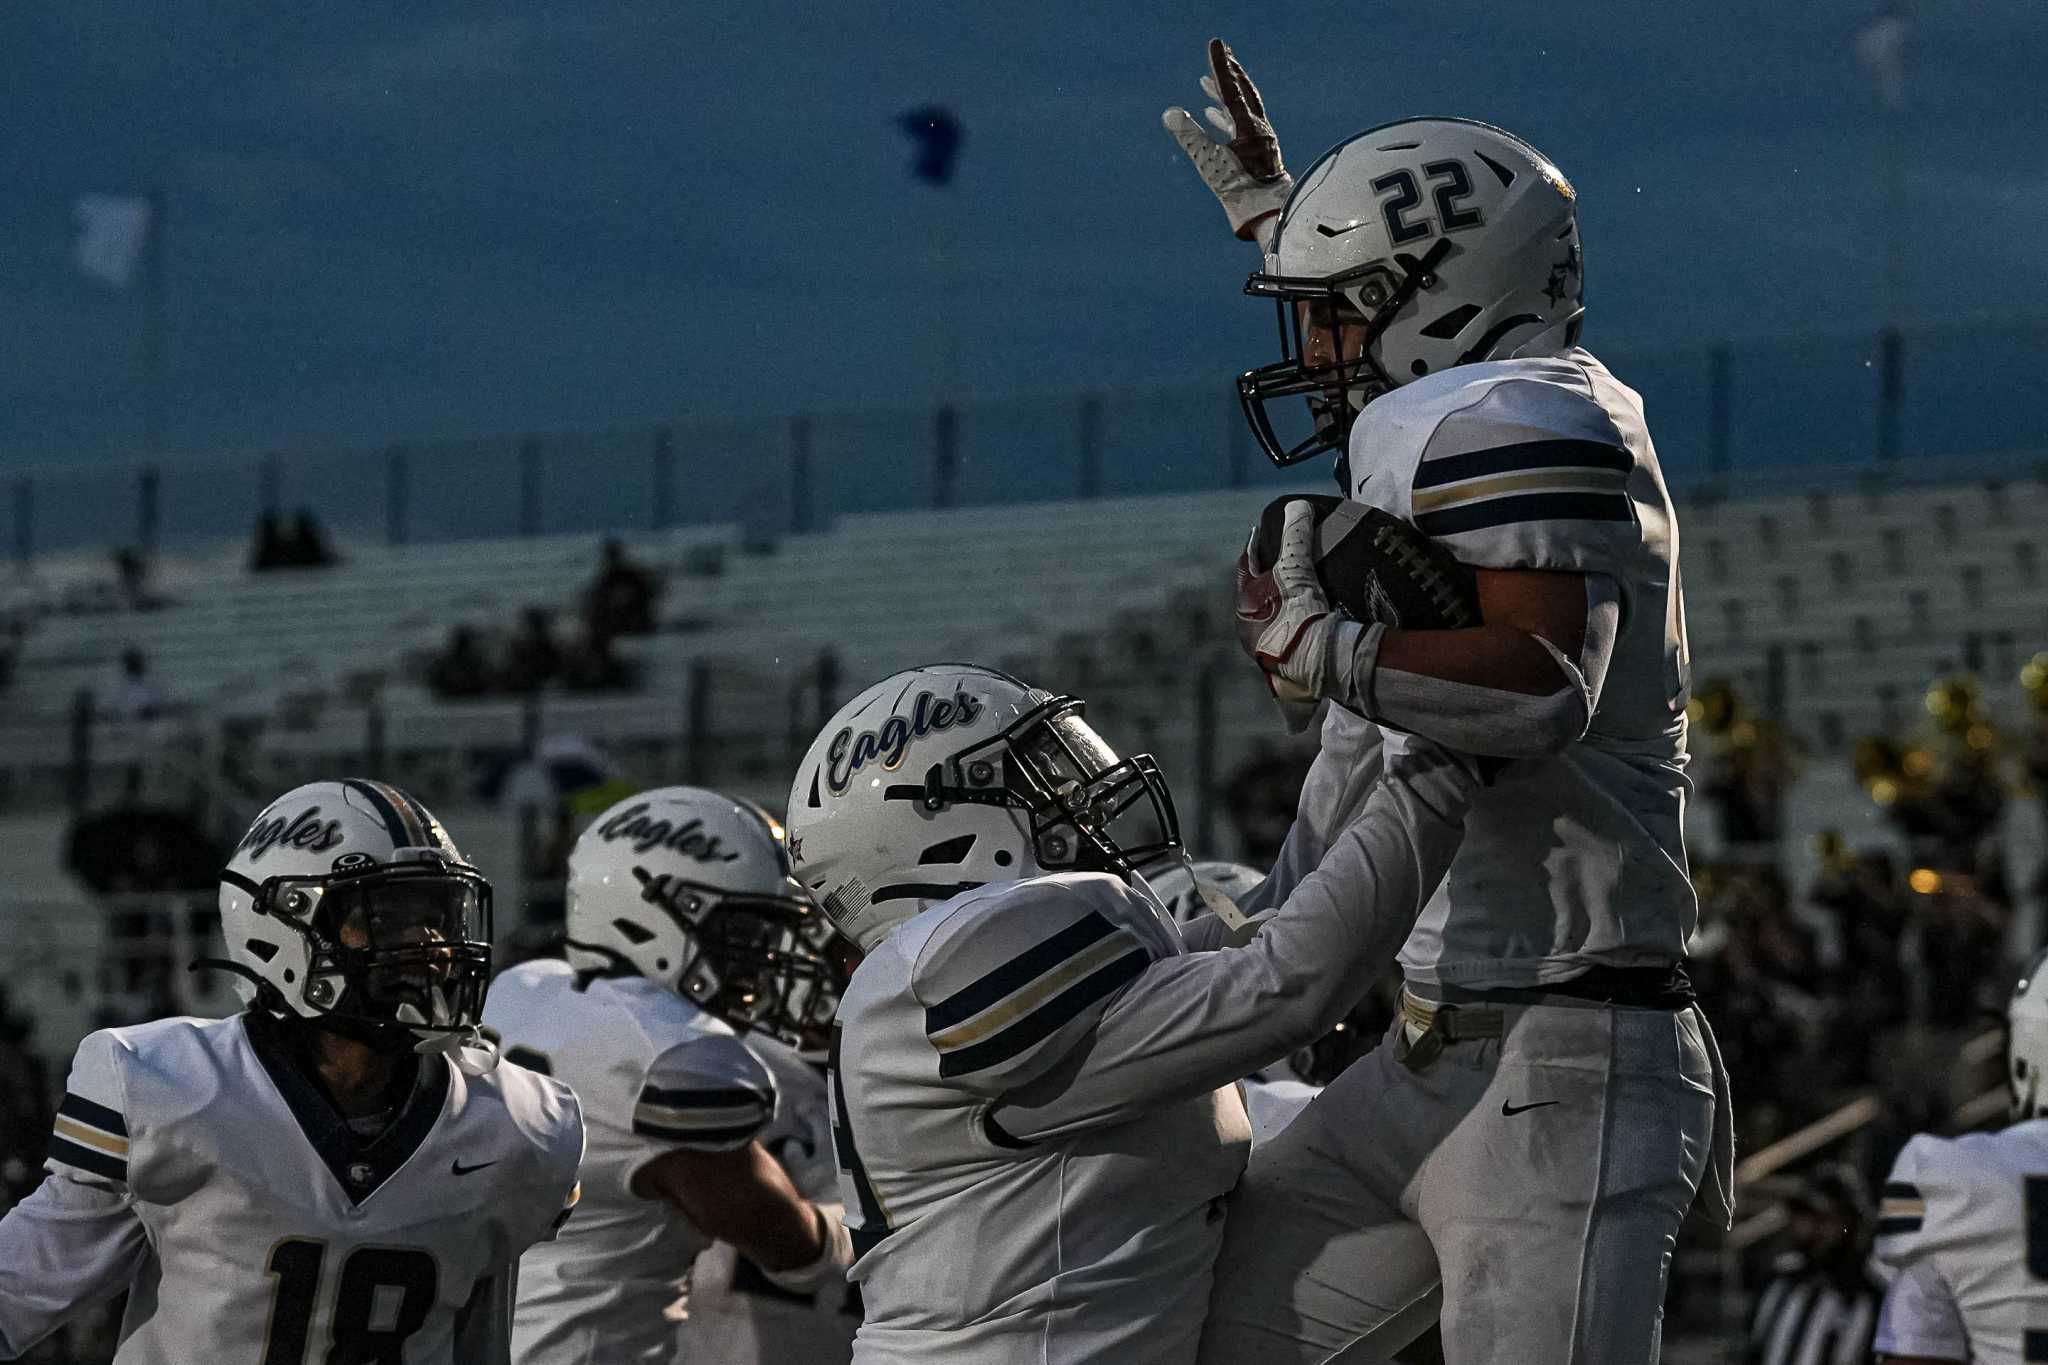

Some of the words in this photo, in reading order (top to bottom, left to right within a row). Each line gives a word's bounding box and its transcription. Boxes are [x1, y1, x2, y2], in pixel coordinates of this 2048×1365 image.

[1369, 158, 1485, 248] 22
[826, 691, 985, 797] Eagles
[239, 805, 344, 864] agles
[598, 803, 739, 863] Eagles
[264, 1235, 440, 1365] 18
